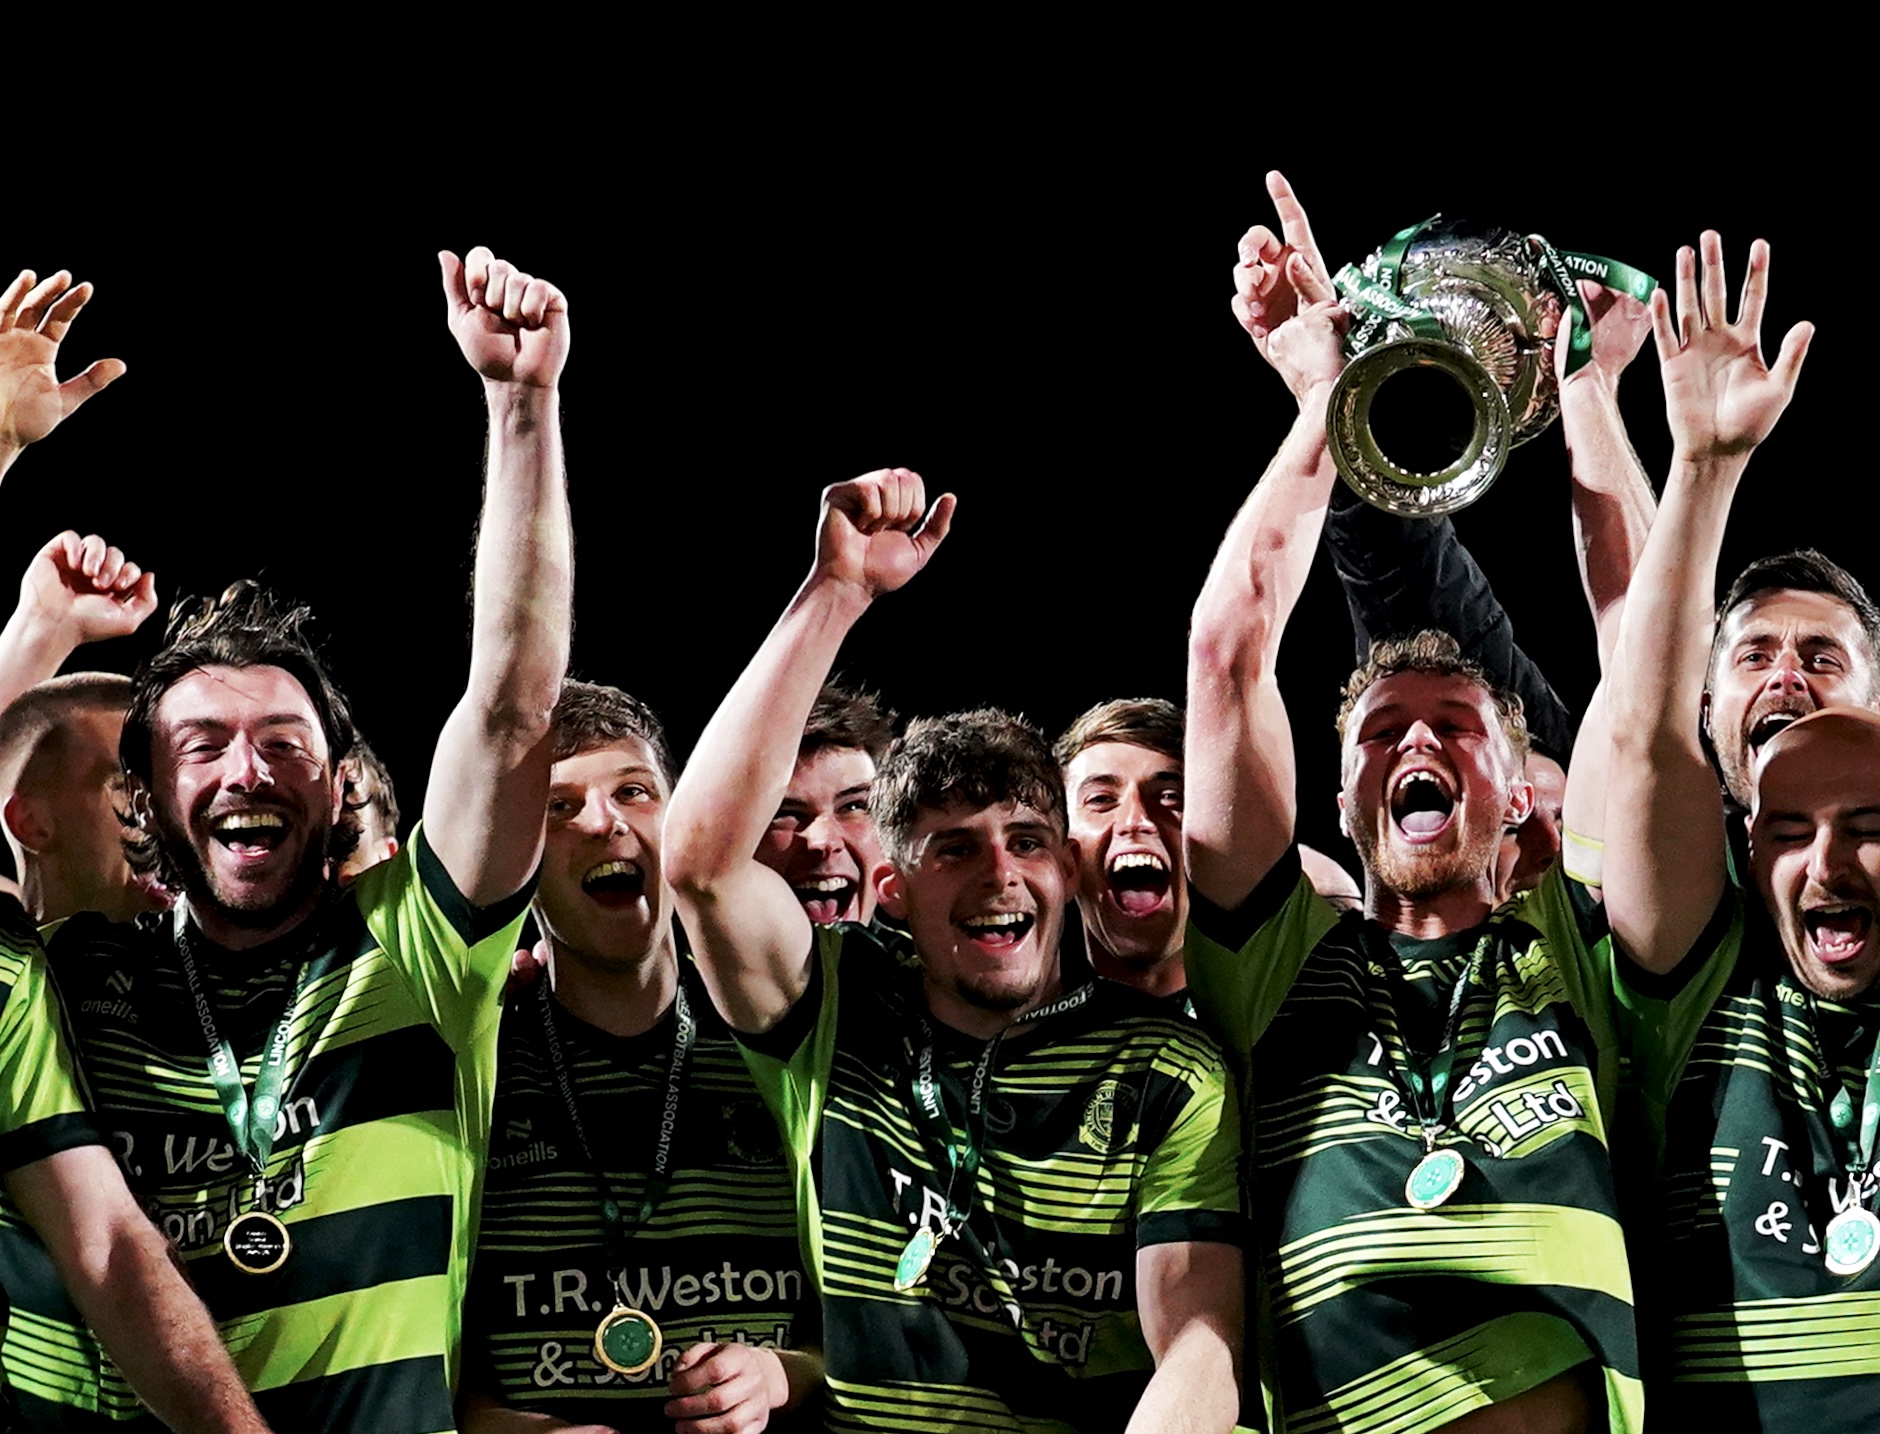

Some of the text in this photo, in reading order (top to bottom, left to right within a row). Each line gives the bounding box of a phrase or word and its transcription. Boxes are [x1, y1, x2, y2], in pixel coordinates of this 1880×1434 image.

[195, 992, 230, 1077] ASSOCIATION
[1452, 1029, 1568, 1102] eston
[654, 1081, 678, 1175] ASSOCIATION
[1490, 1079, 1584, 1140] Ltd
[1754, 1201, 1792, 1243] &
[503, 1261, 802, 1317] T.R. Weston
[984, 1241, 1123, 1301] eston
[533, 1341, 576, 1388] &
[1040, 1320, 1093, 1362] td
